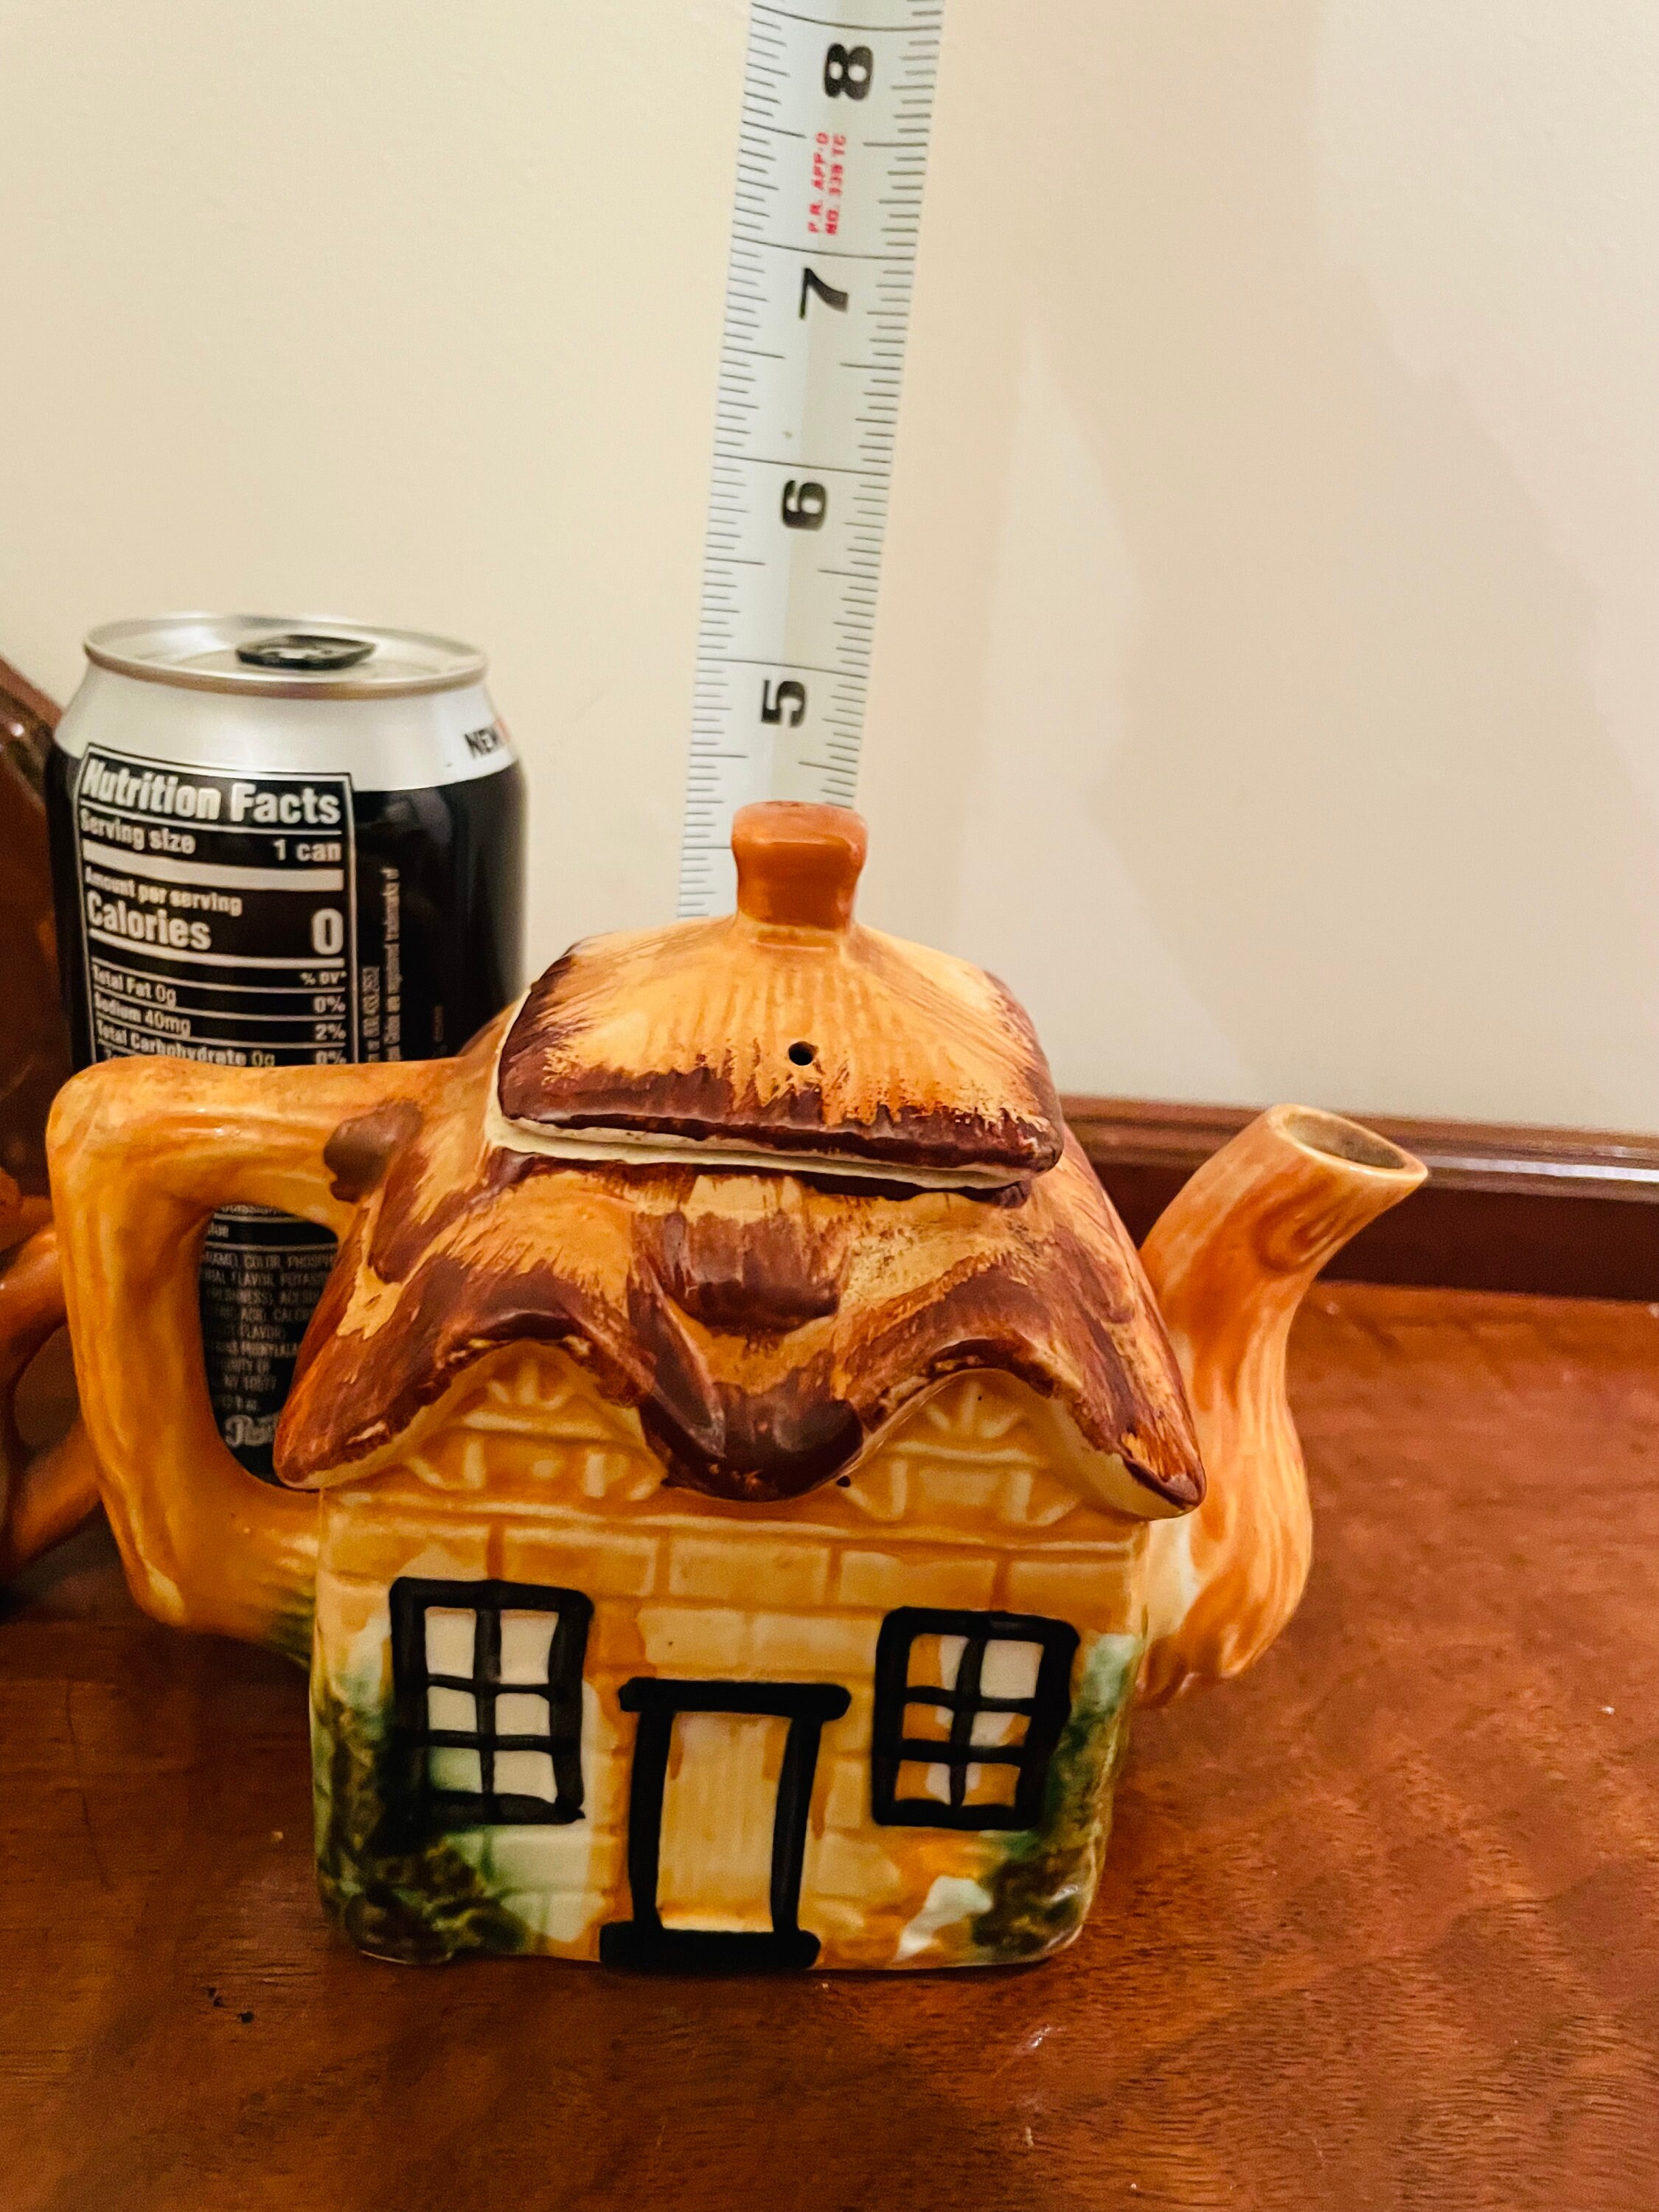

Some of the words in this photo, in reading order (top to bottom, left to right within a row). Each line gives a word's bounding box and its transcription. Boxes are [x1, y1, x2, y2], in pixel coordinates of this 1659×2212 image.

[824, 43, 874, 102] 8
[800, 268, 849, 319] 7
[782, 480, 827, 530] 6
[762, 679, 805, 727] 5
[83, 757, 220, 821] Nutrition
[229, 783, 341, 824] Facts
[80, 808, 145, 849] Serving
[149, 827, 196, 855] size
[274, 840, 285, 860] 1
[296, 843, 341, 862] can
[86, 891, 212, 951] Calories
[139, 881, 166, 906] per
[169, 888, 242, 917] serving
[312, 908, 344, 956] 0
[94, 966, 124, 987] Total
[127, 978, 152, 999] Fat
[156, 984, 177, 1009] 0g
[313, 995, 346, 1014] 0%
[95, 992, 142, 1023] Sodium
[145, 1009, 192, 1040] 40mg
[315, 1023, 347, 1041] 2%
[98, 1019, 128, 1046] Total
[130, 1033, 248, 1066] Carbohydrate
[316, 1050, 347, 1065] 0%
